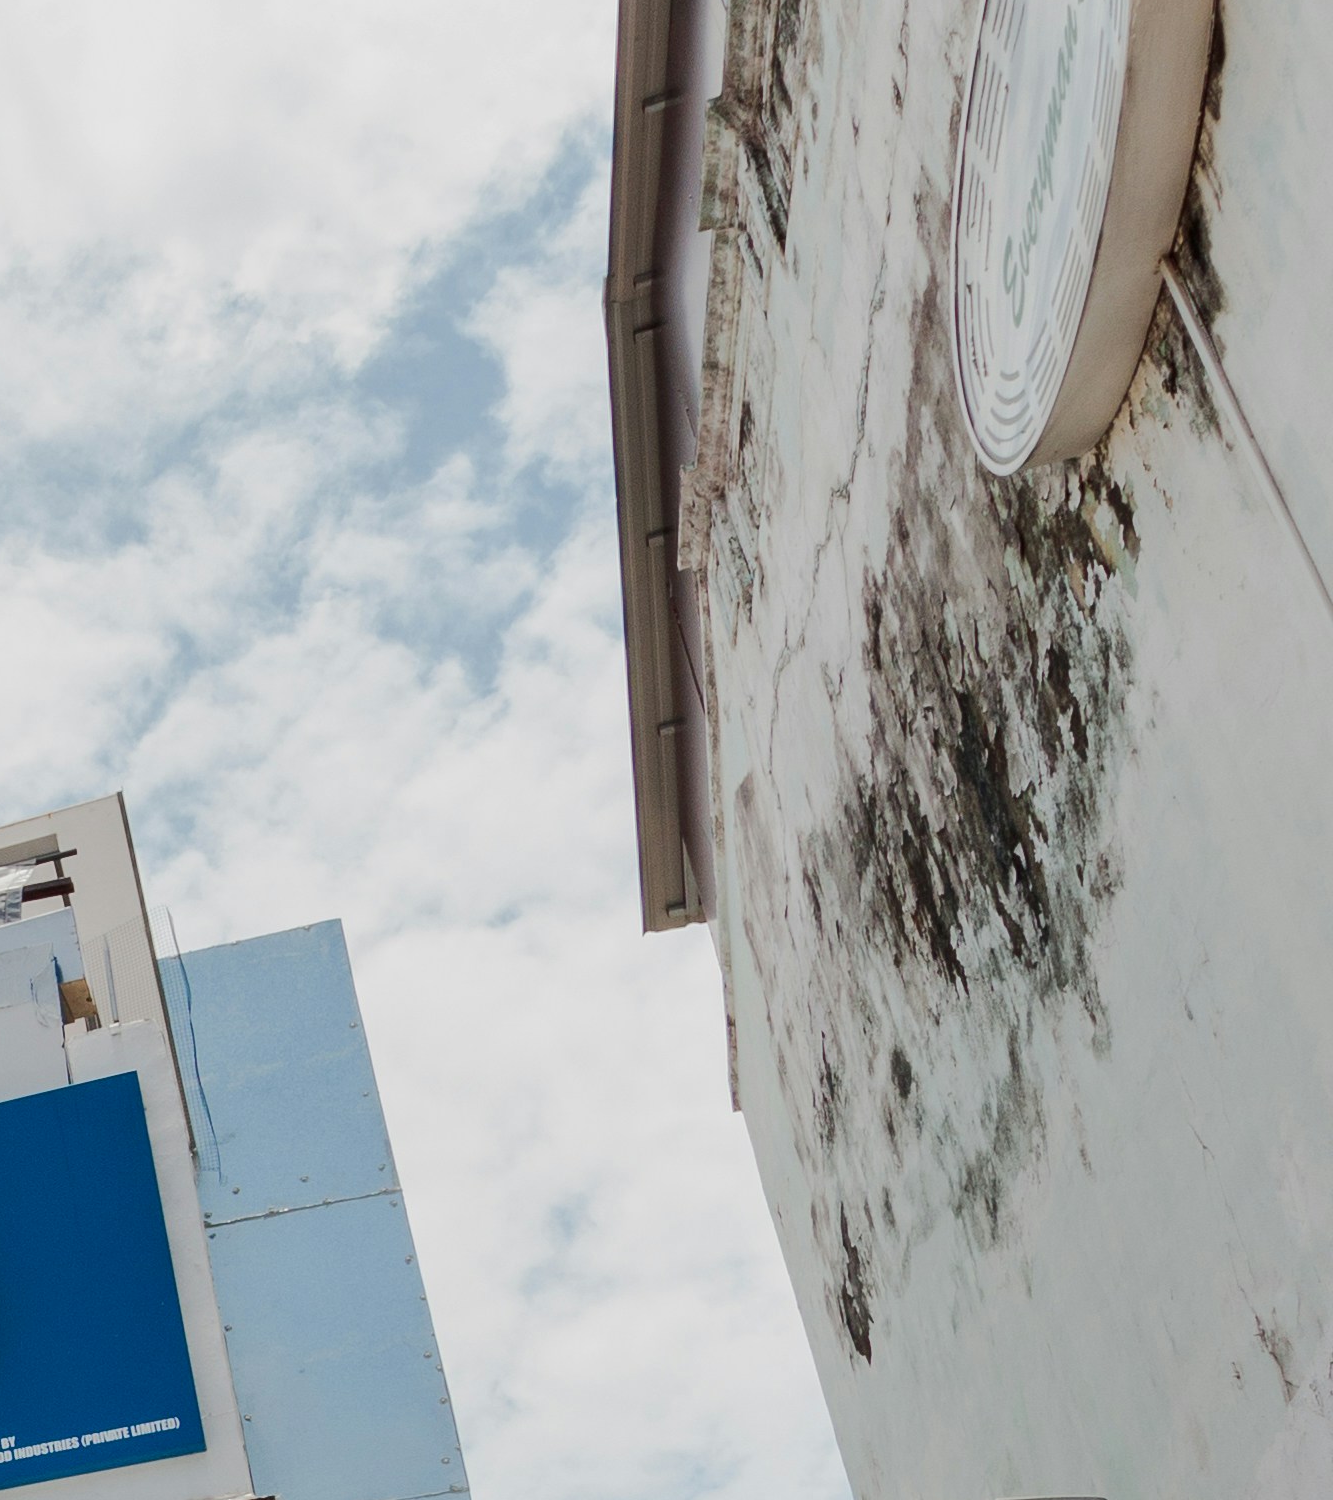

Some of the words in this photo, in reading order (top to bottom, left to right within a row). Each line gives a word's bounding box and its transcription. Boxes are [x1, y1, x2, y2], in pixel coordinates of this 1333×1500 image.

[0, 1435, 16, 1451] BY
[14, 1436, 80, 1460] INDUSTRIES
[81, 1426, 130, 1448] (PRIVATE
[130, 1416, 181, 1438] LIMITED)
